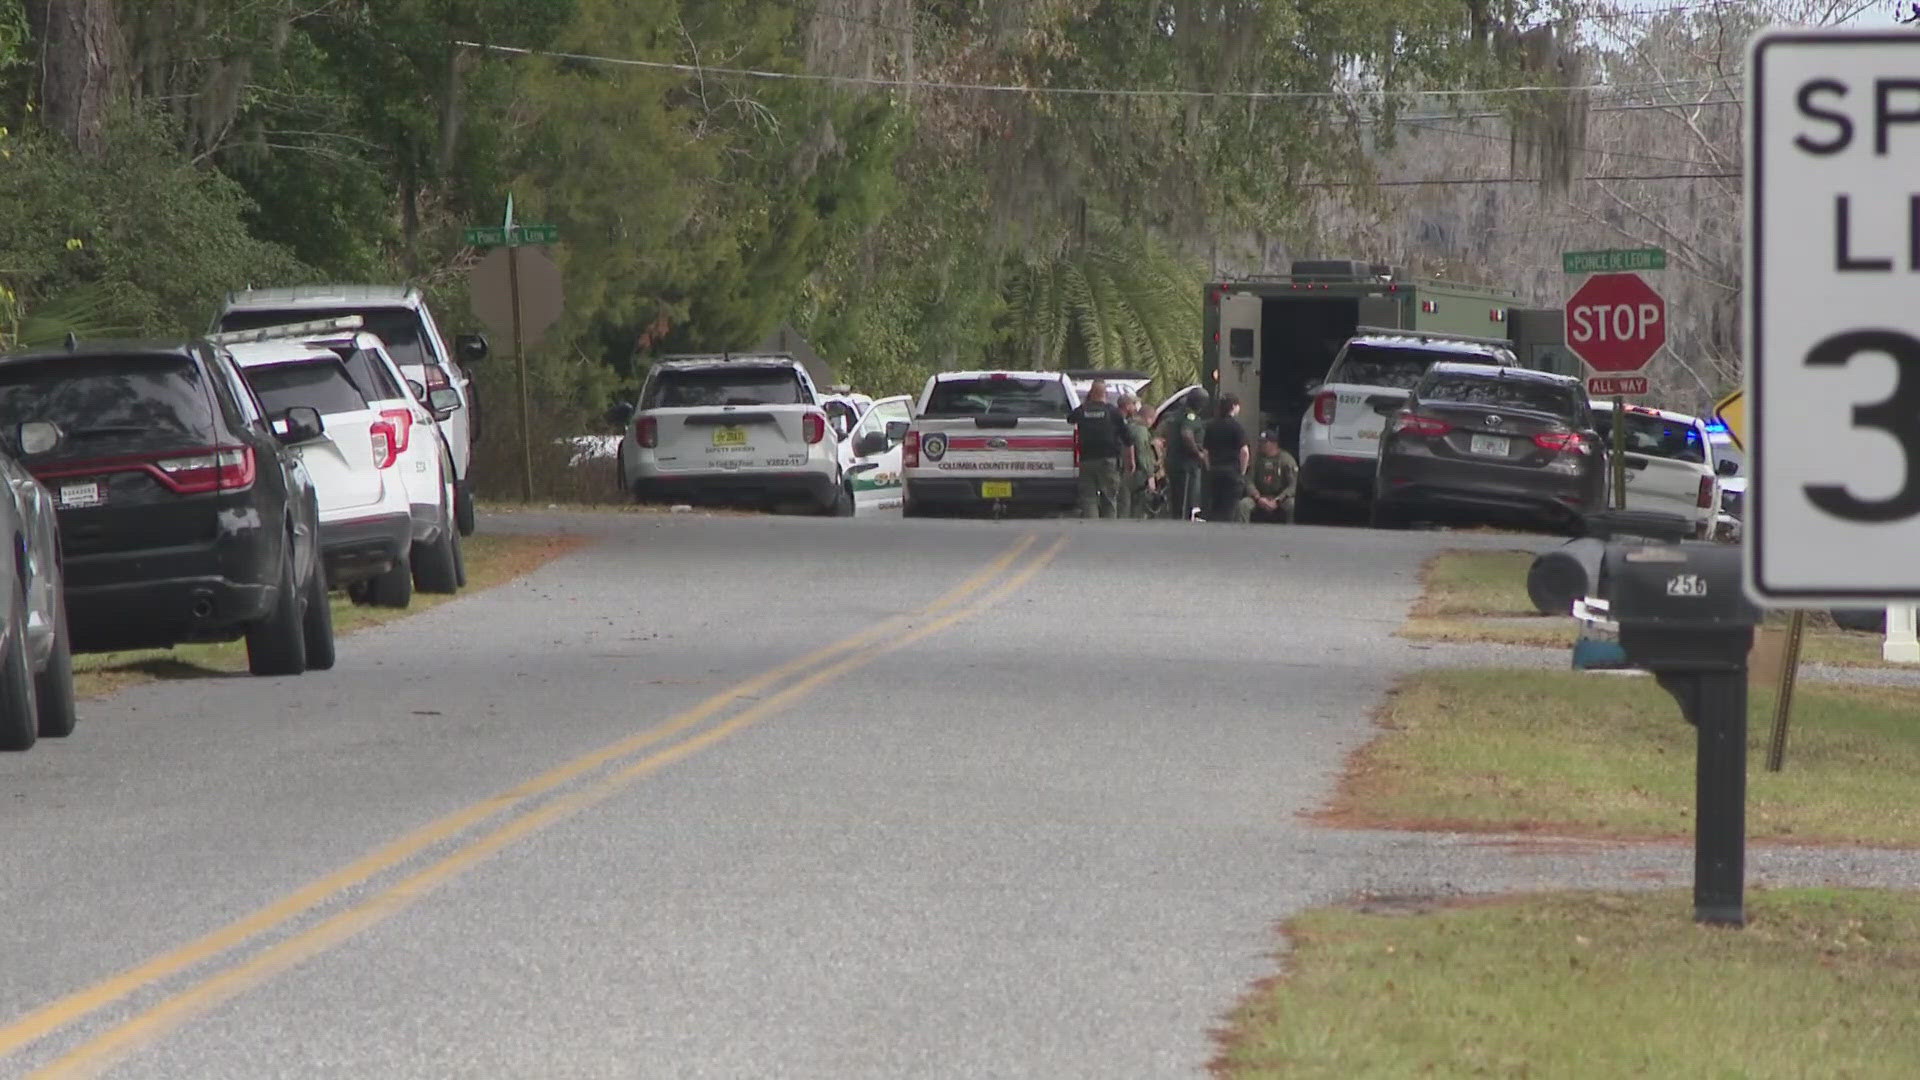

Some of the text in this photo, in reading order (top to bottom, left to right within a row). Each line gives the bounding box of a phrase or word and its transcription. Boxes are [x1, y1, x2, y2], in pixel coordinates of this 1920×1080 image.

[1574, 254, 1608, 270] PONCE
[1610, 253, 1623, 268] DE
[1624, 252, 1651, 267] LEON
[1573, 304, 1659, 341] STOP
[1592, 380, 1643, 392] ALL WAY
[1803, 327, 1920, 524] 3
[938, 461, 1055, 470] COLUMBIA COUNTY FIRE RESCUE
[1669, 576, 1705, 594] 256
